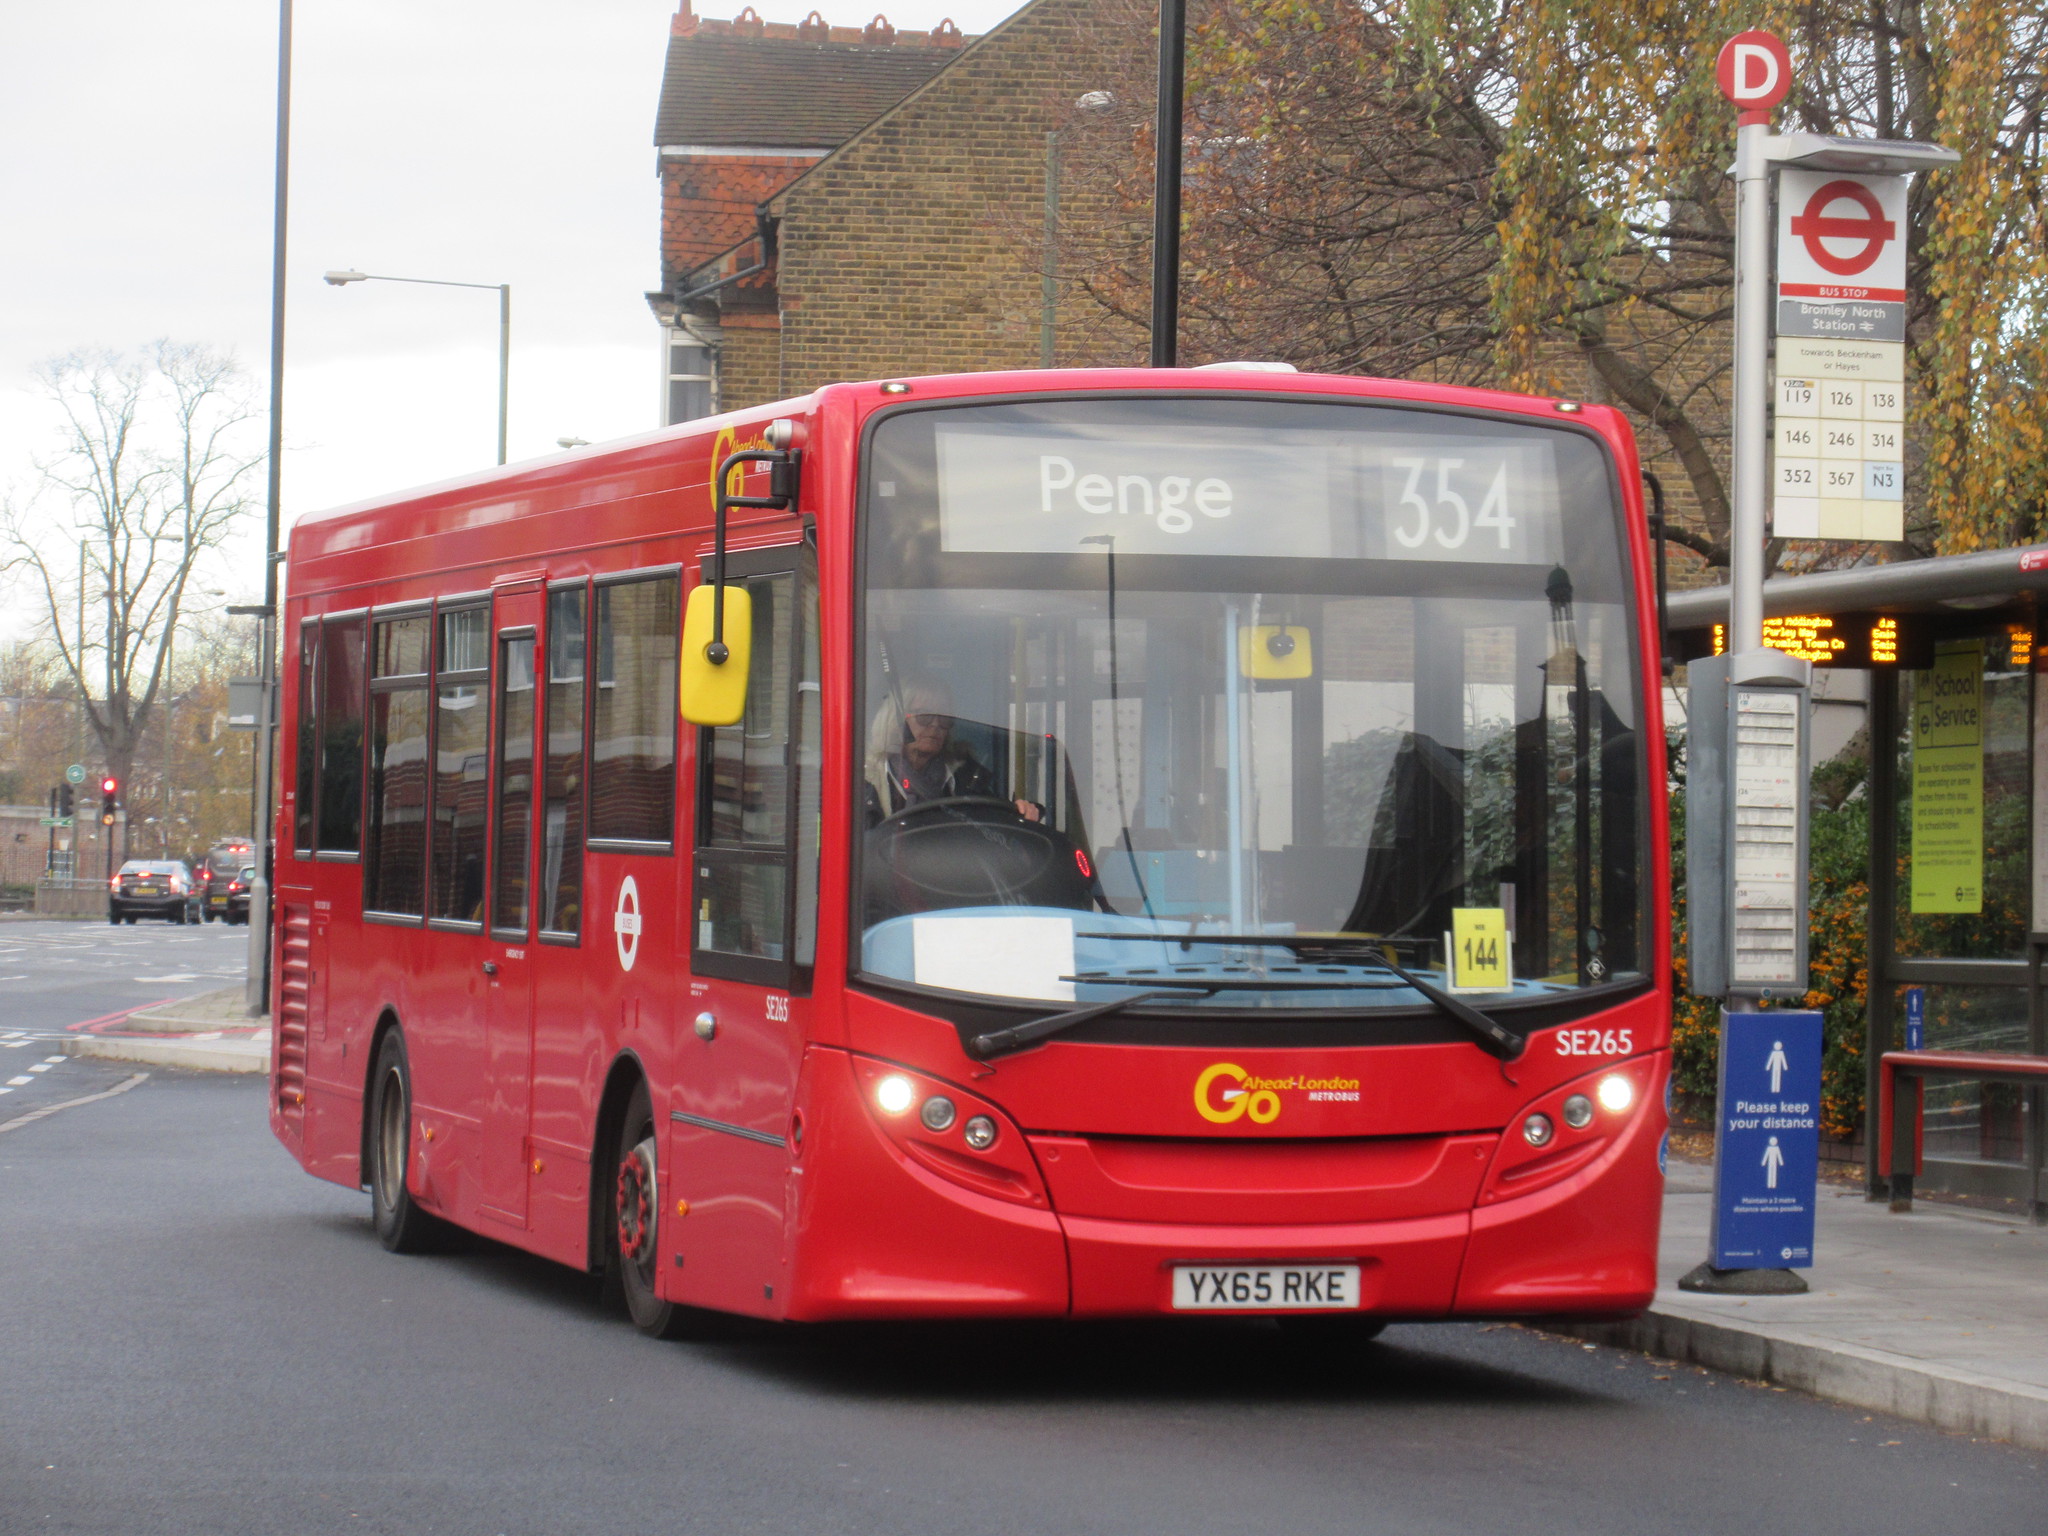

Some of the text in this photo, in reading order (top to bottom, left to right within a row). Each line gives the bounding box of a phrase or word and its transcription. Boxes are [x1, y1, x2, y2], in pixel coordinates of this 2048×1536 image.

[1734, 44, 1779, 99] D
[1820, 287, 1869, 298] BUS STOP
[1801, 303, 1886, 319] Bromley North
[1812, 318, 1856, 331] Station
[1801, 348, 1884, 359] towards Beckenham
[1824, 362, 1861, 372] or Hayes
[1786, 390, 1812, 403] 119
[1831, 391, 1854, 406] 126
[1873, 394, 1896, 408] 138
[1786, 430, 1812, 444] 146
[1829, 431, 1856, 446] 246
[1872, 433, 1895, 448] 314
[1784, 469, 1812, 483] 352
[1829, 471, 1855, 486] 367
[1873, 474, 1894, 487] N3
[1040, 455, 1233, 535] Penge
[1393, 457, 1517, 550] 354
[1785, 615, 1832, 629] Addington
[1714, 625, 1723, 636] 5
[1763, 627, 1796, 639] Purley
[1798, 628, 1817, 639] Way
[1714, 637, 1723, 647] 6
[1763, 637, 1802, 650] Bromley
[1805, 638, 1829, 649] Town
[1831, 639, 1845, 649] Cn
[1935, 672, 1975, 696] School
[1935, 704, 1977, 728] Service
[1465, 937, 1498, 972] 144
[766, 994, 789, 1023] SE265
[1556, 1028, 1633, 1056] SE265
[1194, 1062, 1282, 1125] Go
[1308, 1091, 1361, 1102] METROBUS
[1737, 1101, 1810, 1115] Please keep
[1729, 1117, 1815, 1131] your distance
[1189, 1271, 1345, 1302] YX65 RKE
